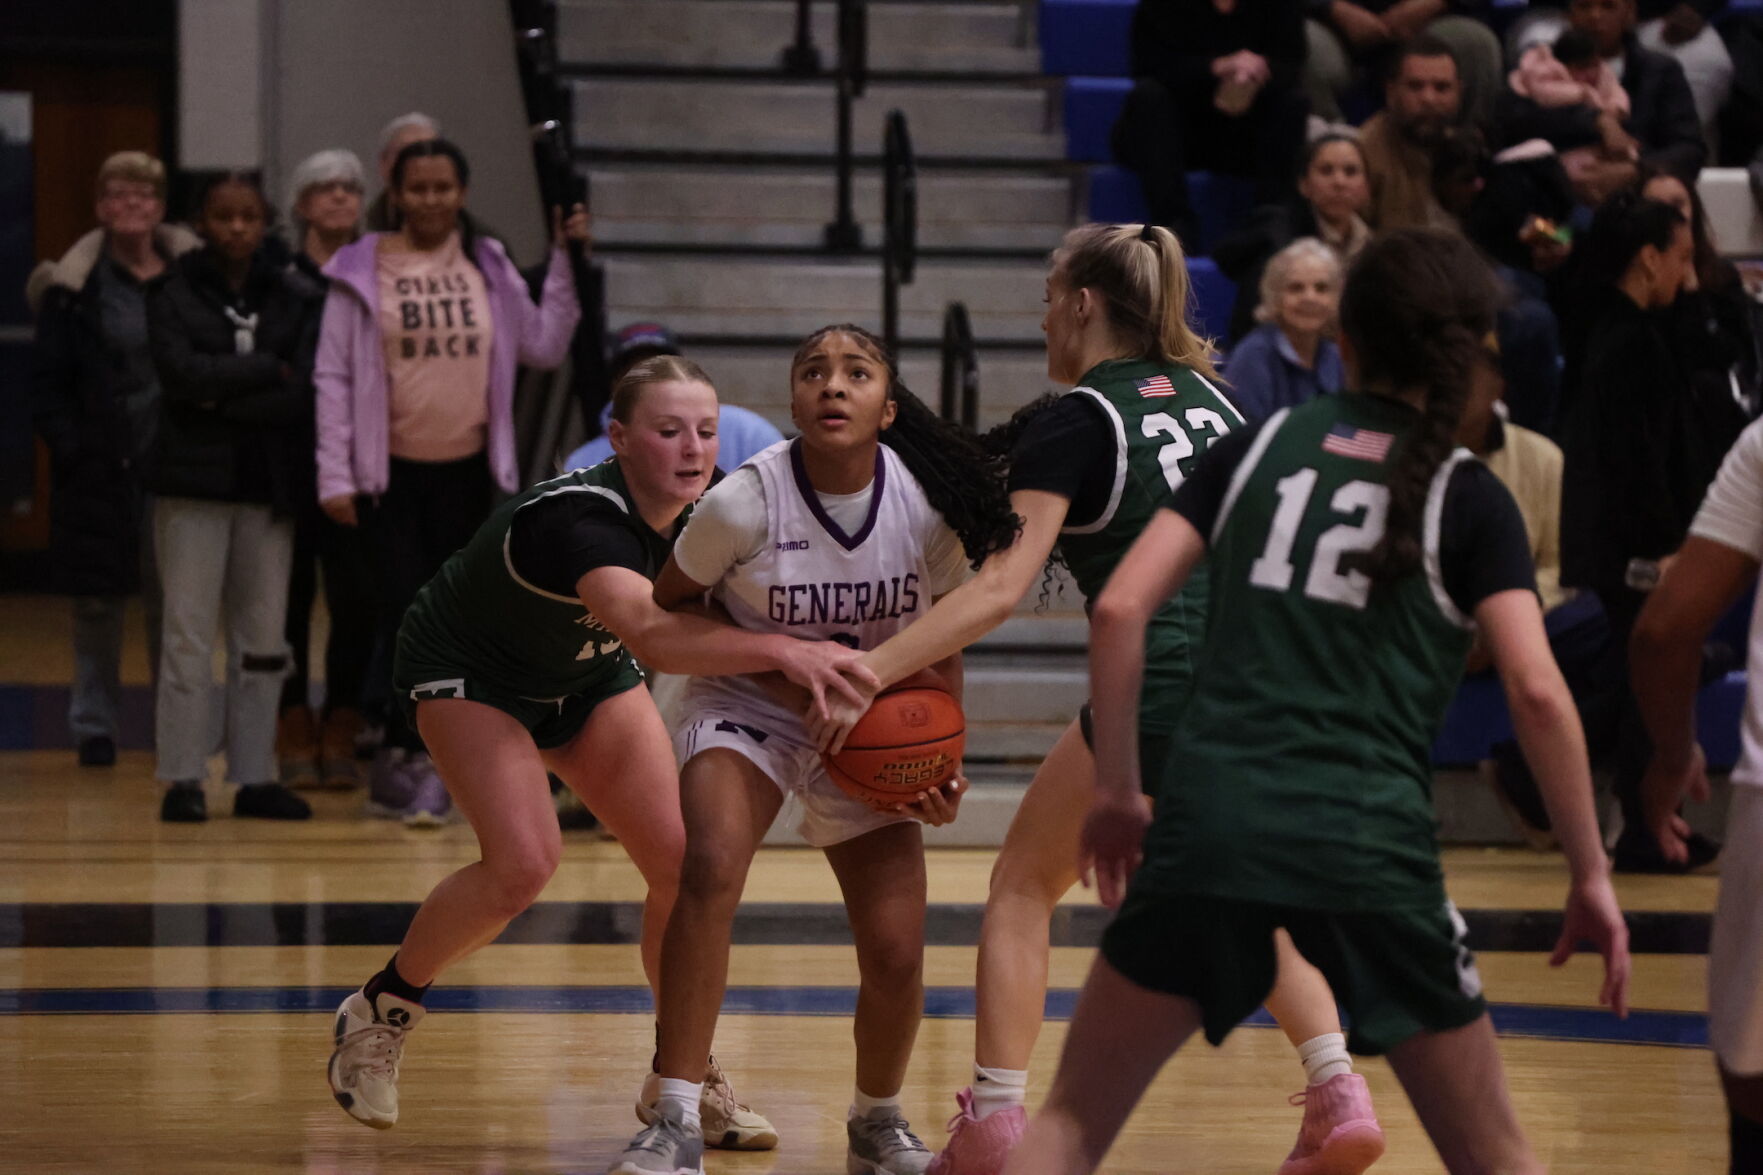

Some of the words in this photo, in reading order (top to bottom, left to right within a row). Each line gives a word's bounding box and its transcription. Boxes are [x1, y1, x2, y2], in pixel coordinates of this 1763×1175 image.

[401, 298, 475, 329] BITE
[401, 334, 481, 359] BACK
[1248, 466, 1393, 612] 12
[768, 573, 919, 626] GENERALS
[873, 758, 955, 785] LEGACY
